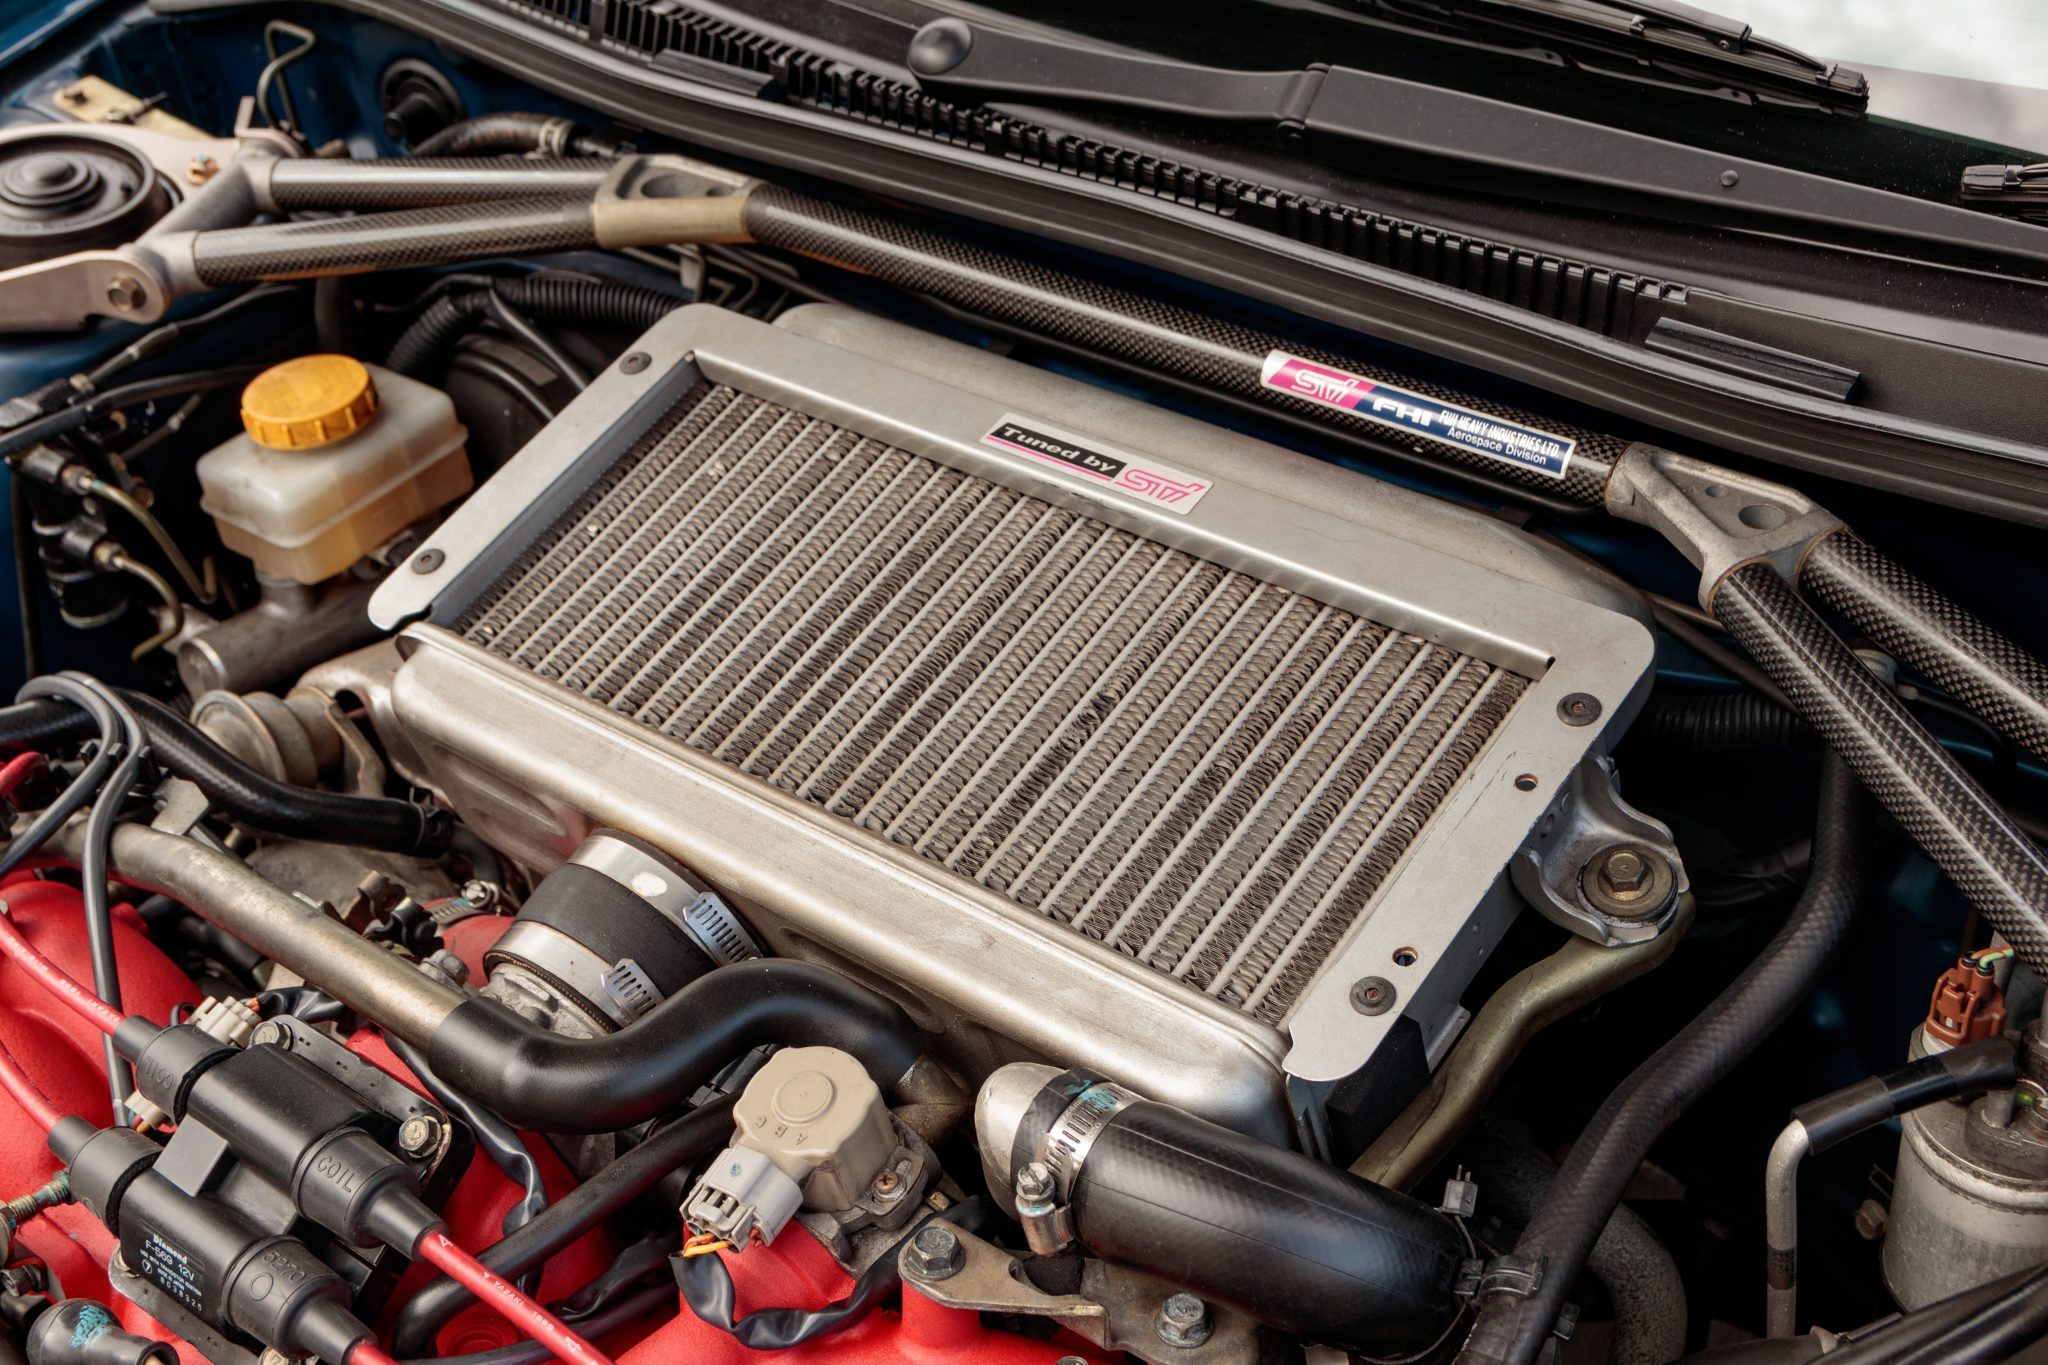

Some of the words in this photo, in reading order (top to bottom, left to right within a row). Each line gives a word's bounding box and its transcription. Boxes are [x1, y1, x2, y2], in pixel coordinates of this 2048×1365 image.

[1372, 397, 1433, 427] FHI
[1003, 426, 1080, 460] Tuned
[1083, 456, 1117, 472] by
[1438, 409, 1459, 427] FUJI
[1457, 414, 1489, 435] HEAVY
[1488, 424, 1542, 453] INDUSTRIES
[1541, 440, 1560, 458] LTD.
[1447, 427, 1503, 451] Aerospace
[1505, 445, 1547, 465] Division
[145, 1055, 174, 1090] COIL
[316, 1155, 355, 1193] COIL
[153, 1233, 188, 1265] Diamond
[438, 1234, 453, 1247] 4
[178, 1263, 194, 1281] 12V
[493, 1280, 525, 1306] YAZAKI
